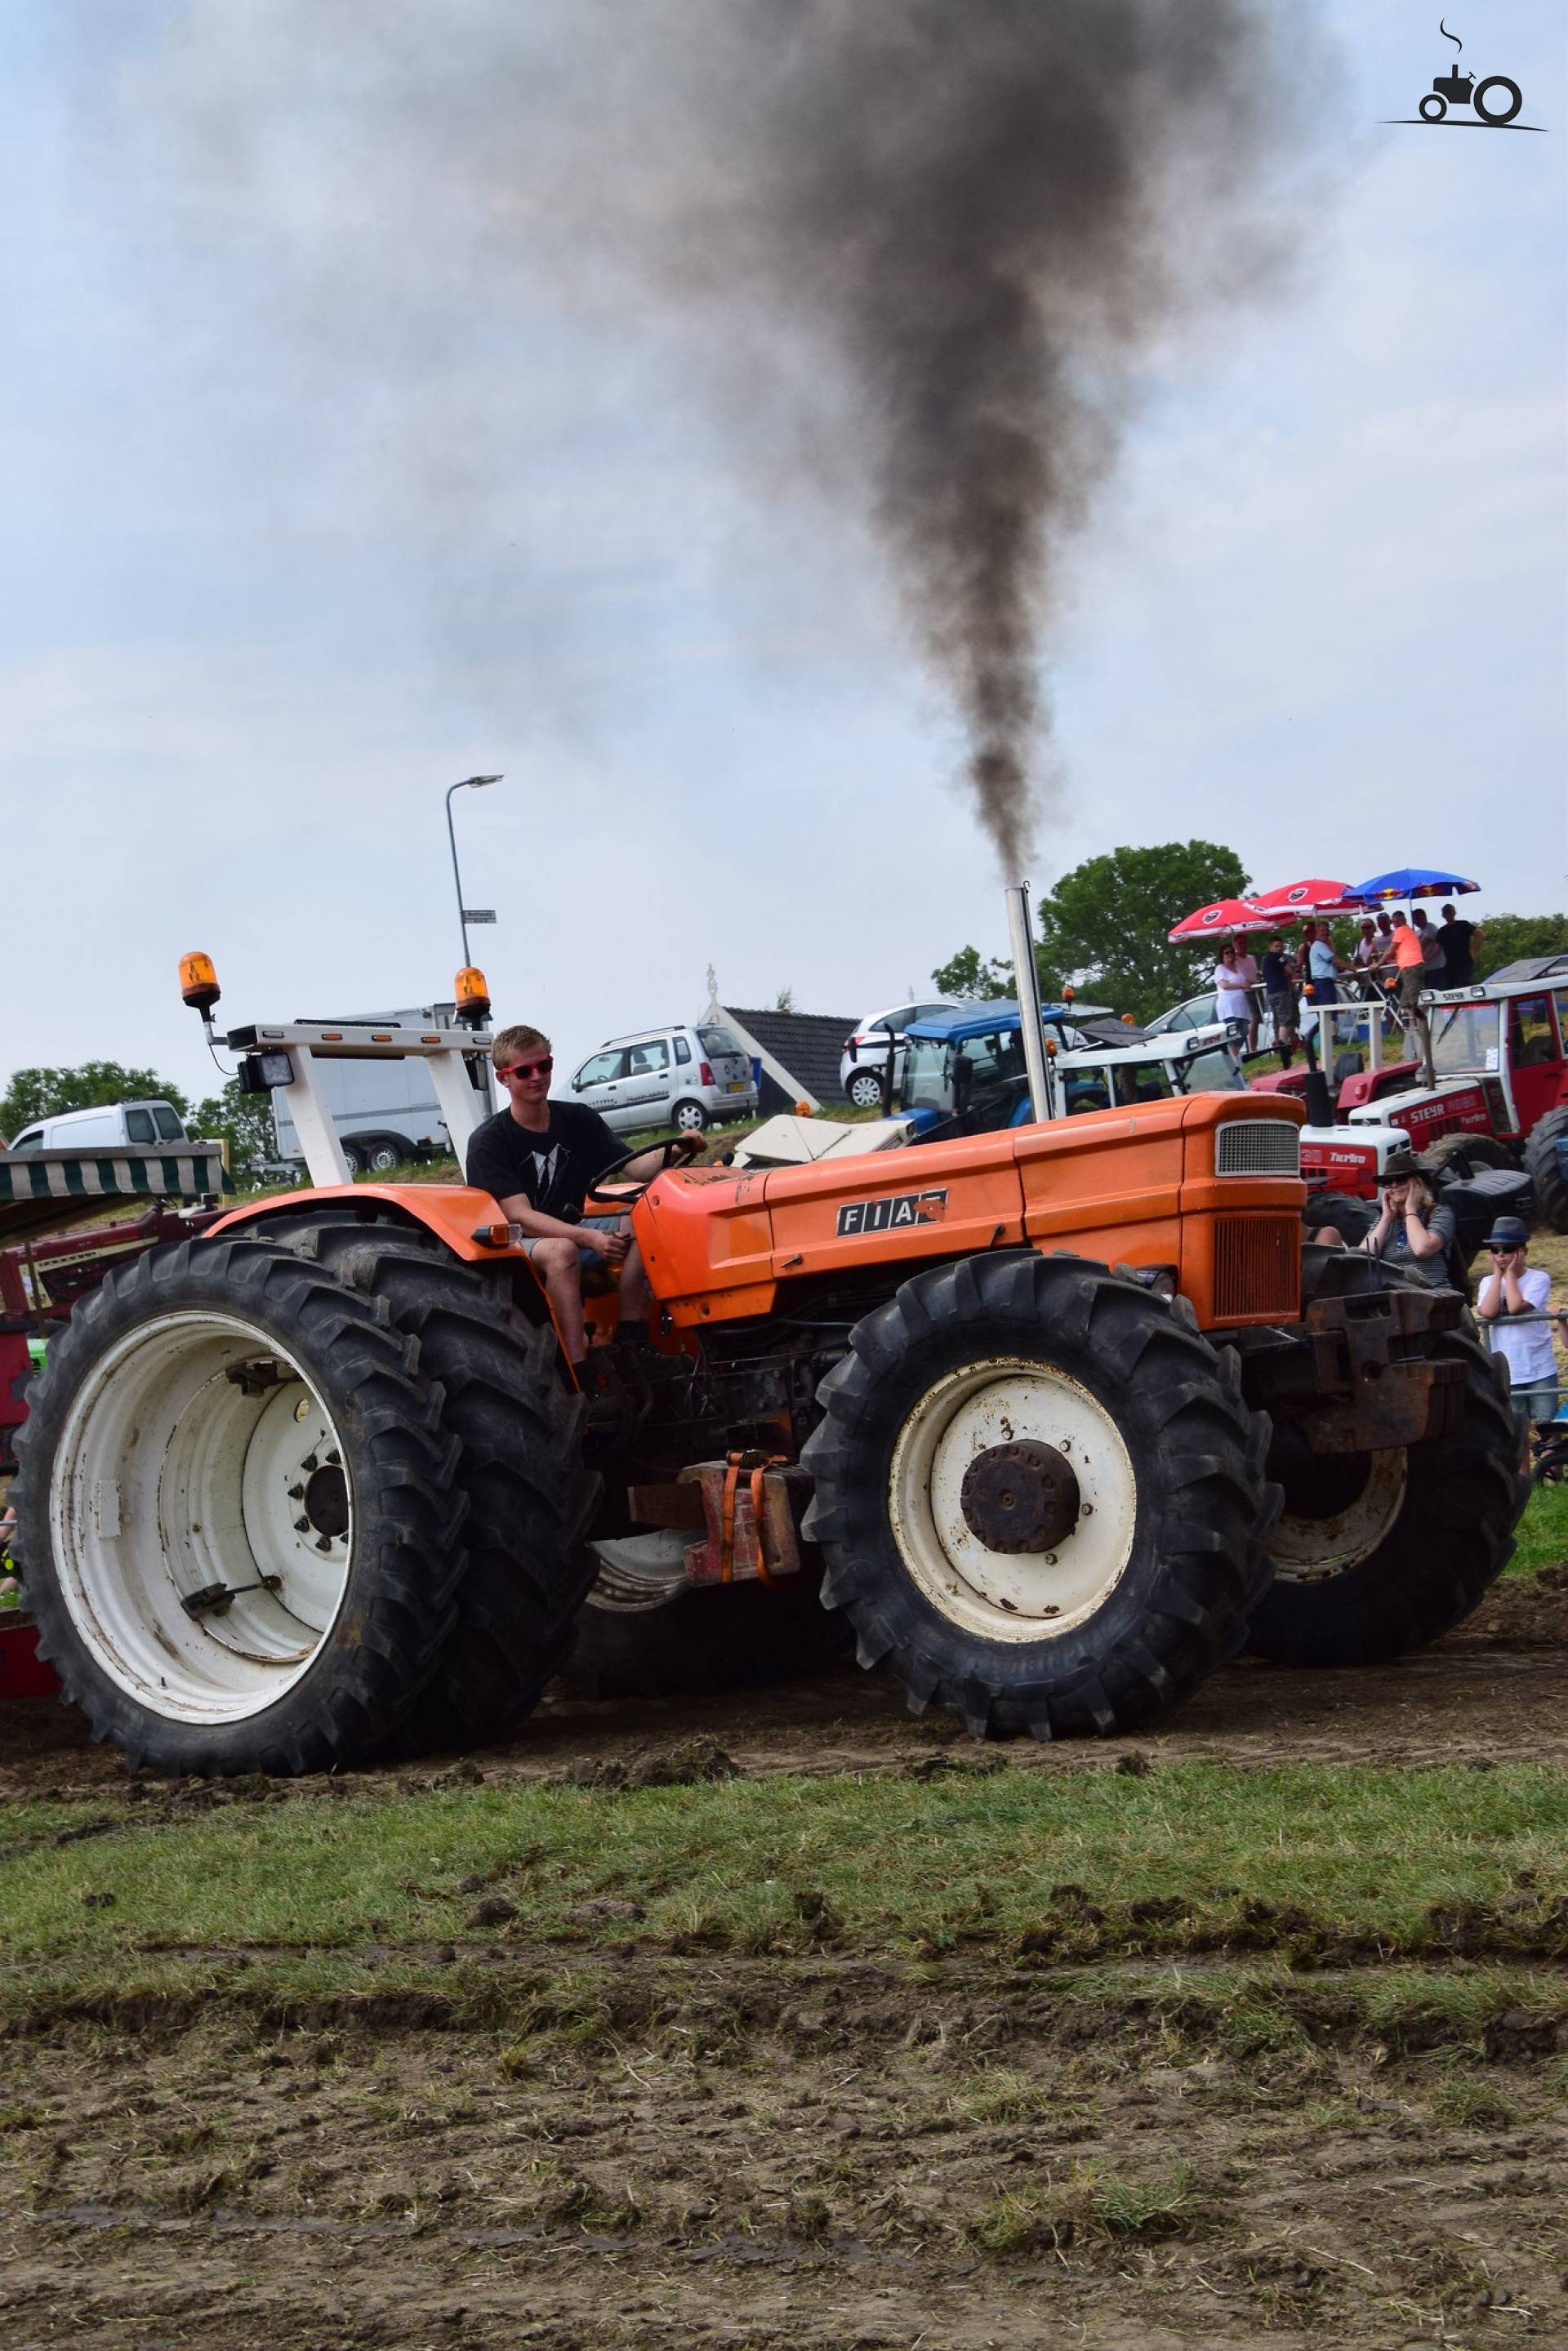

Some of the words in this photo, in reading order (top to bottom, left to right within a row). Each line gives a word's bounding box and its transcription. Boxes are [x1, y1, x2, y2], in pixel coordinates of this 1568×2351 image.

[1410, 1103, 1445, 1124] STEYR
[1330, 1151, 1366, 1164] Turbo
[844, 1196, 941, 1231] FIA
